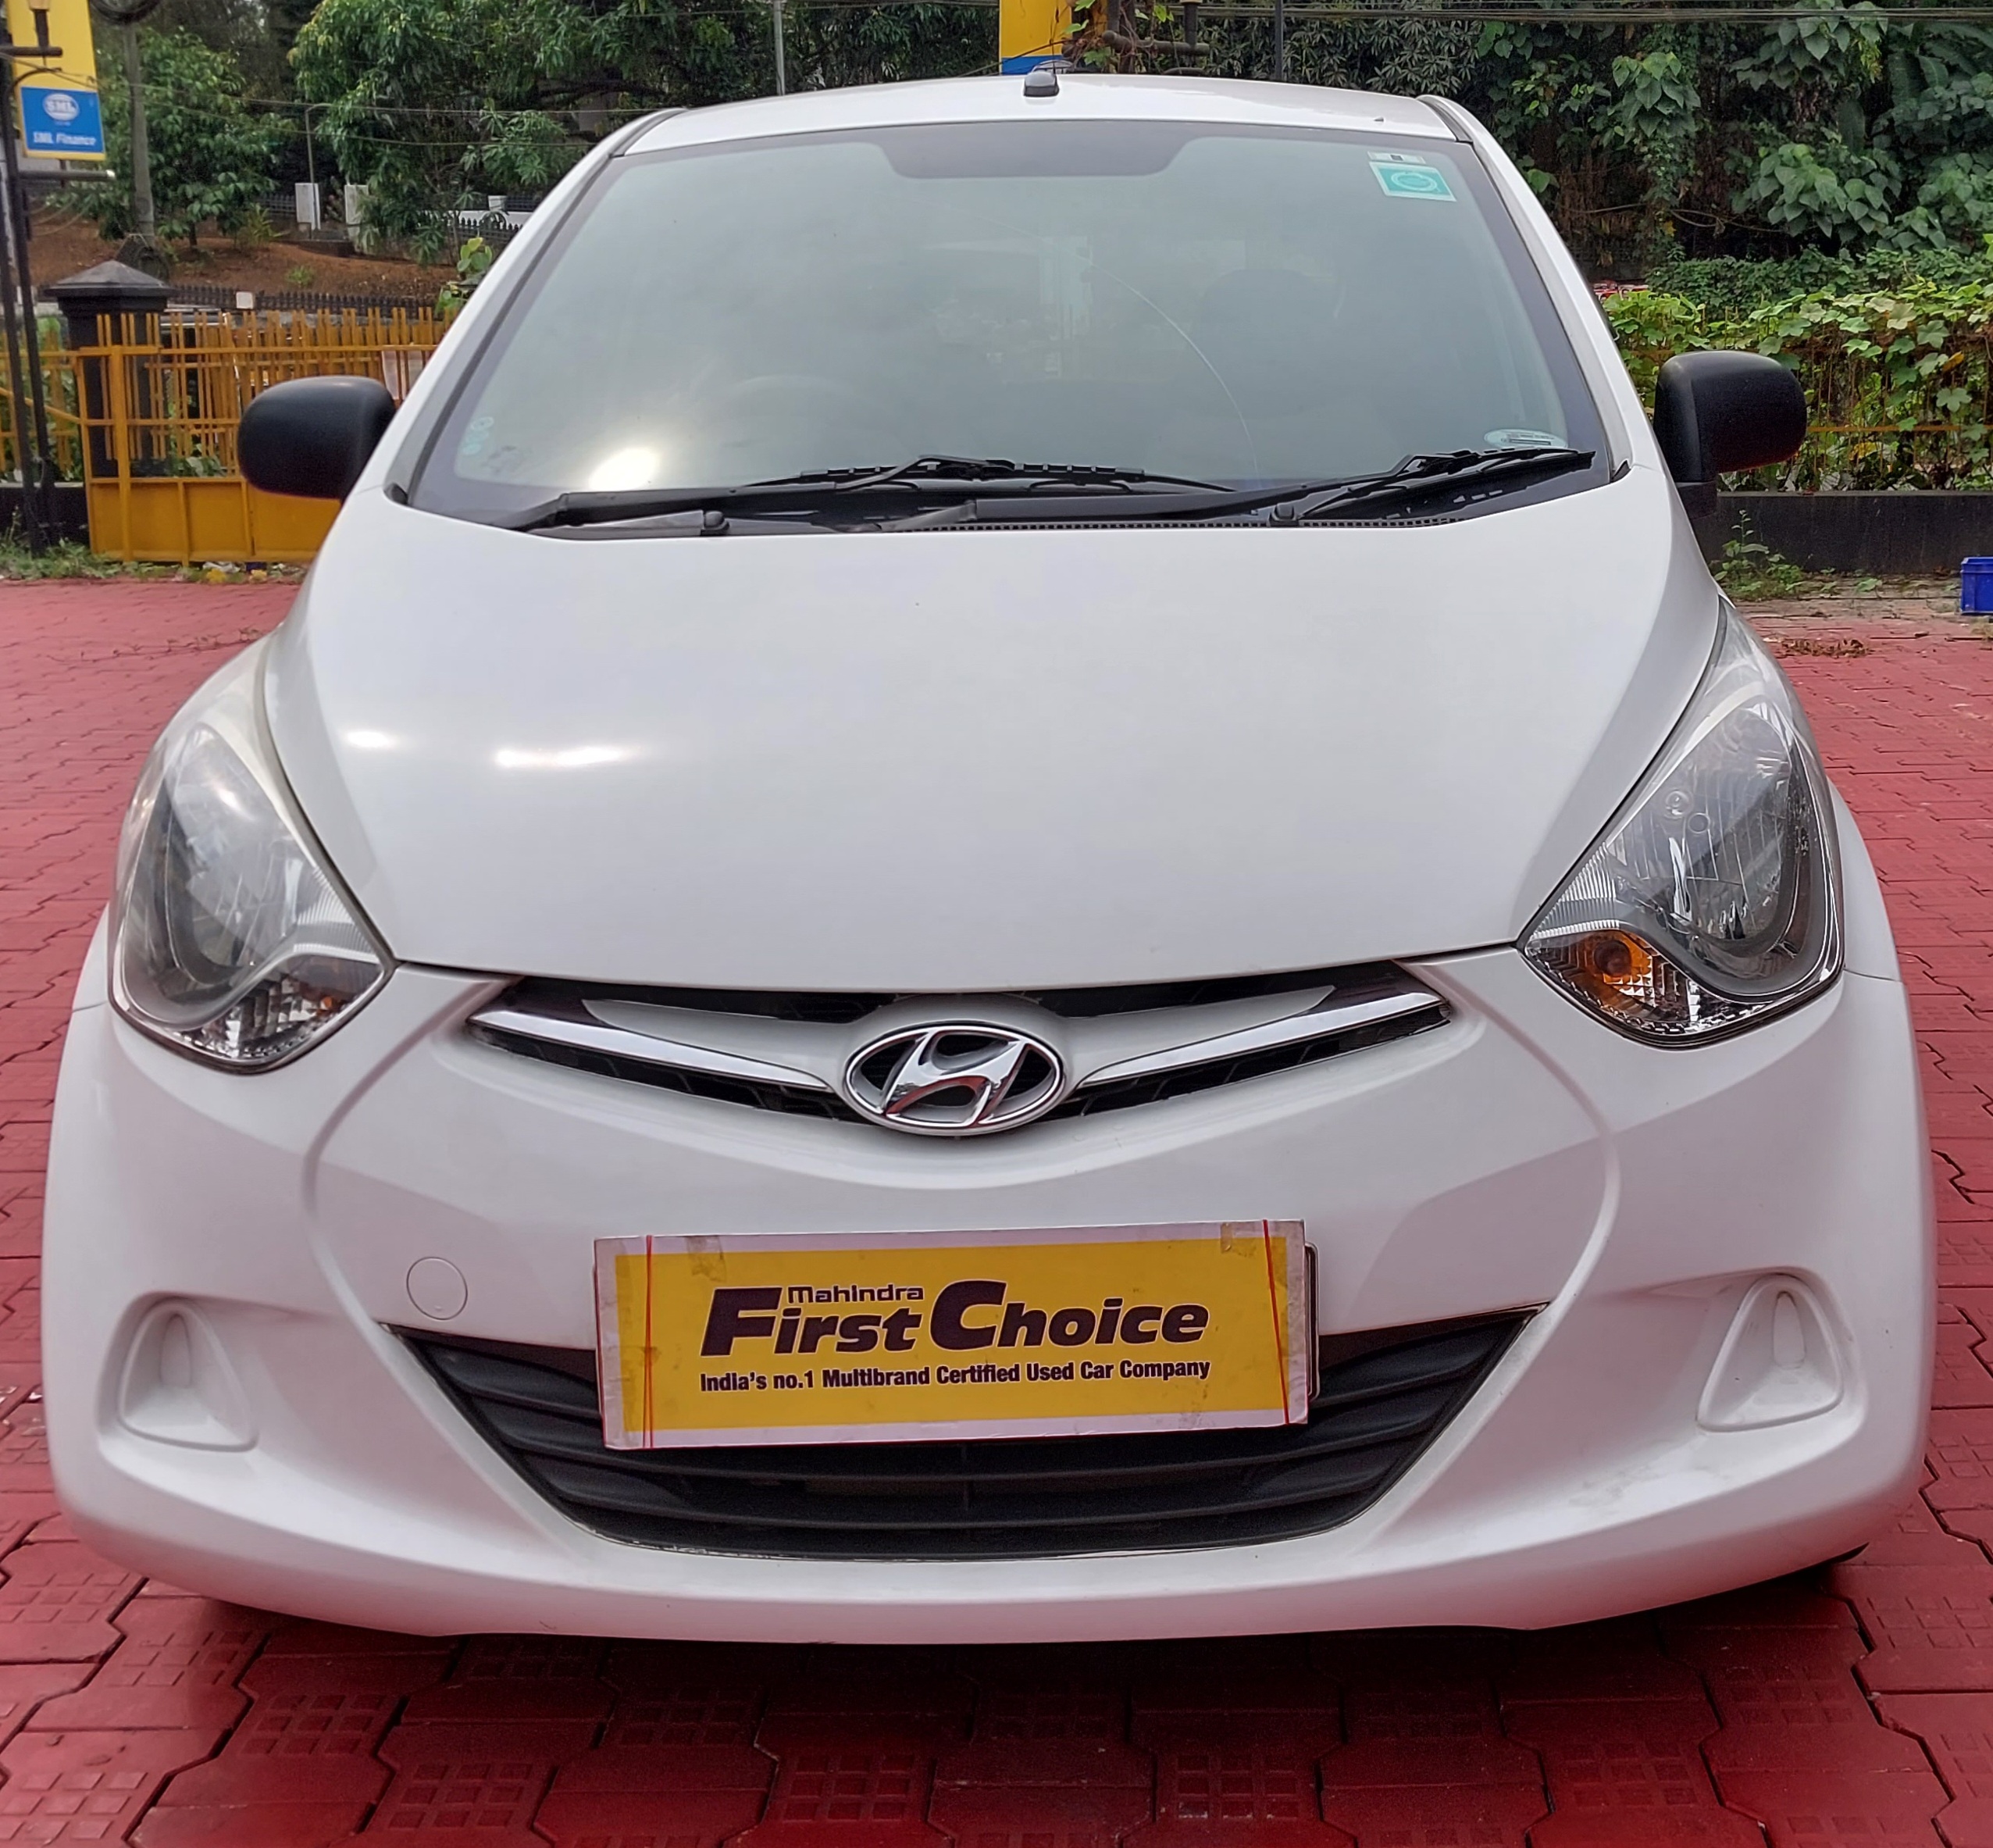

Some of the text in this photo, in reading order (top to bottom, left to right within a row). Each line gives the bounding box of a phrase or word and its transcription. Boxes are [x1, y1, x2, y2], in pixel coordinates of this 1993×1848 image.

[55, 133, 97, 146] Finance
[788, 1284, 924, 1304] Mahindra
[700, 1279, 1210, 1357] First Choice
[700, 1360, 1210, 1392] India's no.1 Multibrand Certified Used Car Company
